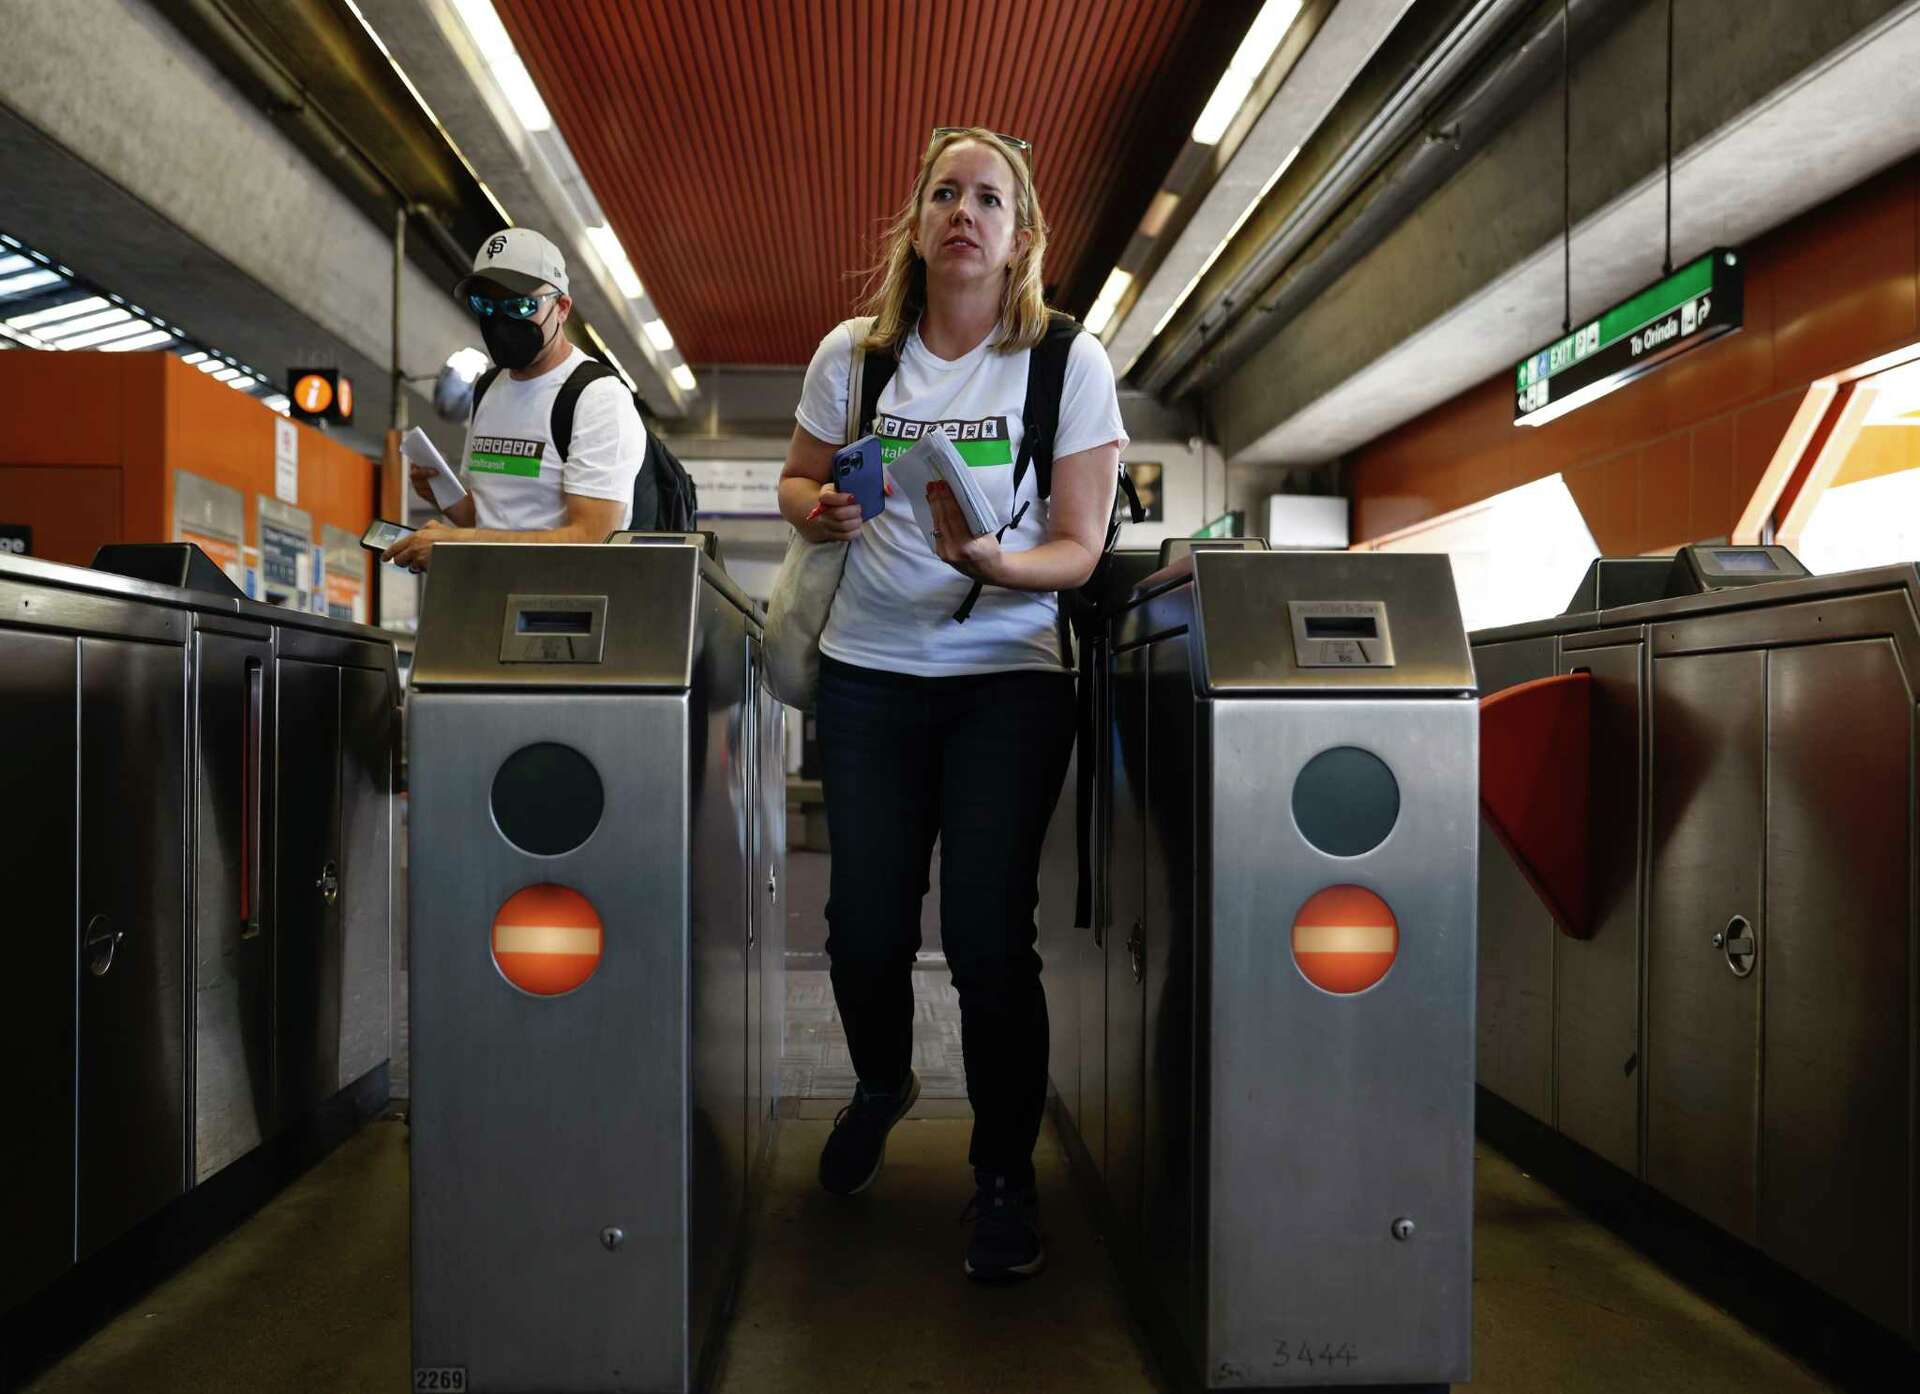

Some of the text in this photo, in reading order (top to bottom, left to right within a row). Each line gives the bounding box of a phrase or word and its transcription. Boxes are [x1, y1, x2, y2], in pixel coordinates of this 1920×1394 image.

[1630, 315, 1678, 356] To Orinda
[1550, 338, 1575, 370] EXIT
[1271, 1338, 1358, 1367] 3444
[416, 1370, 463, 1389] 2269
